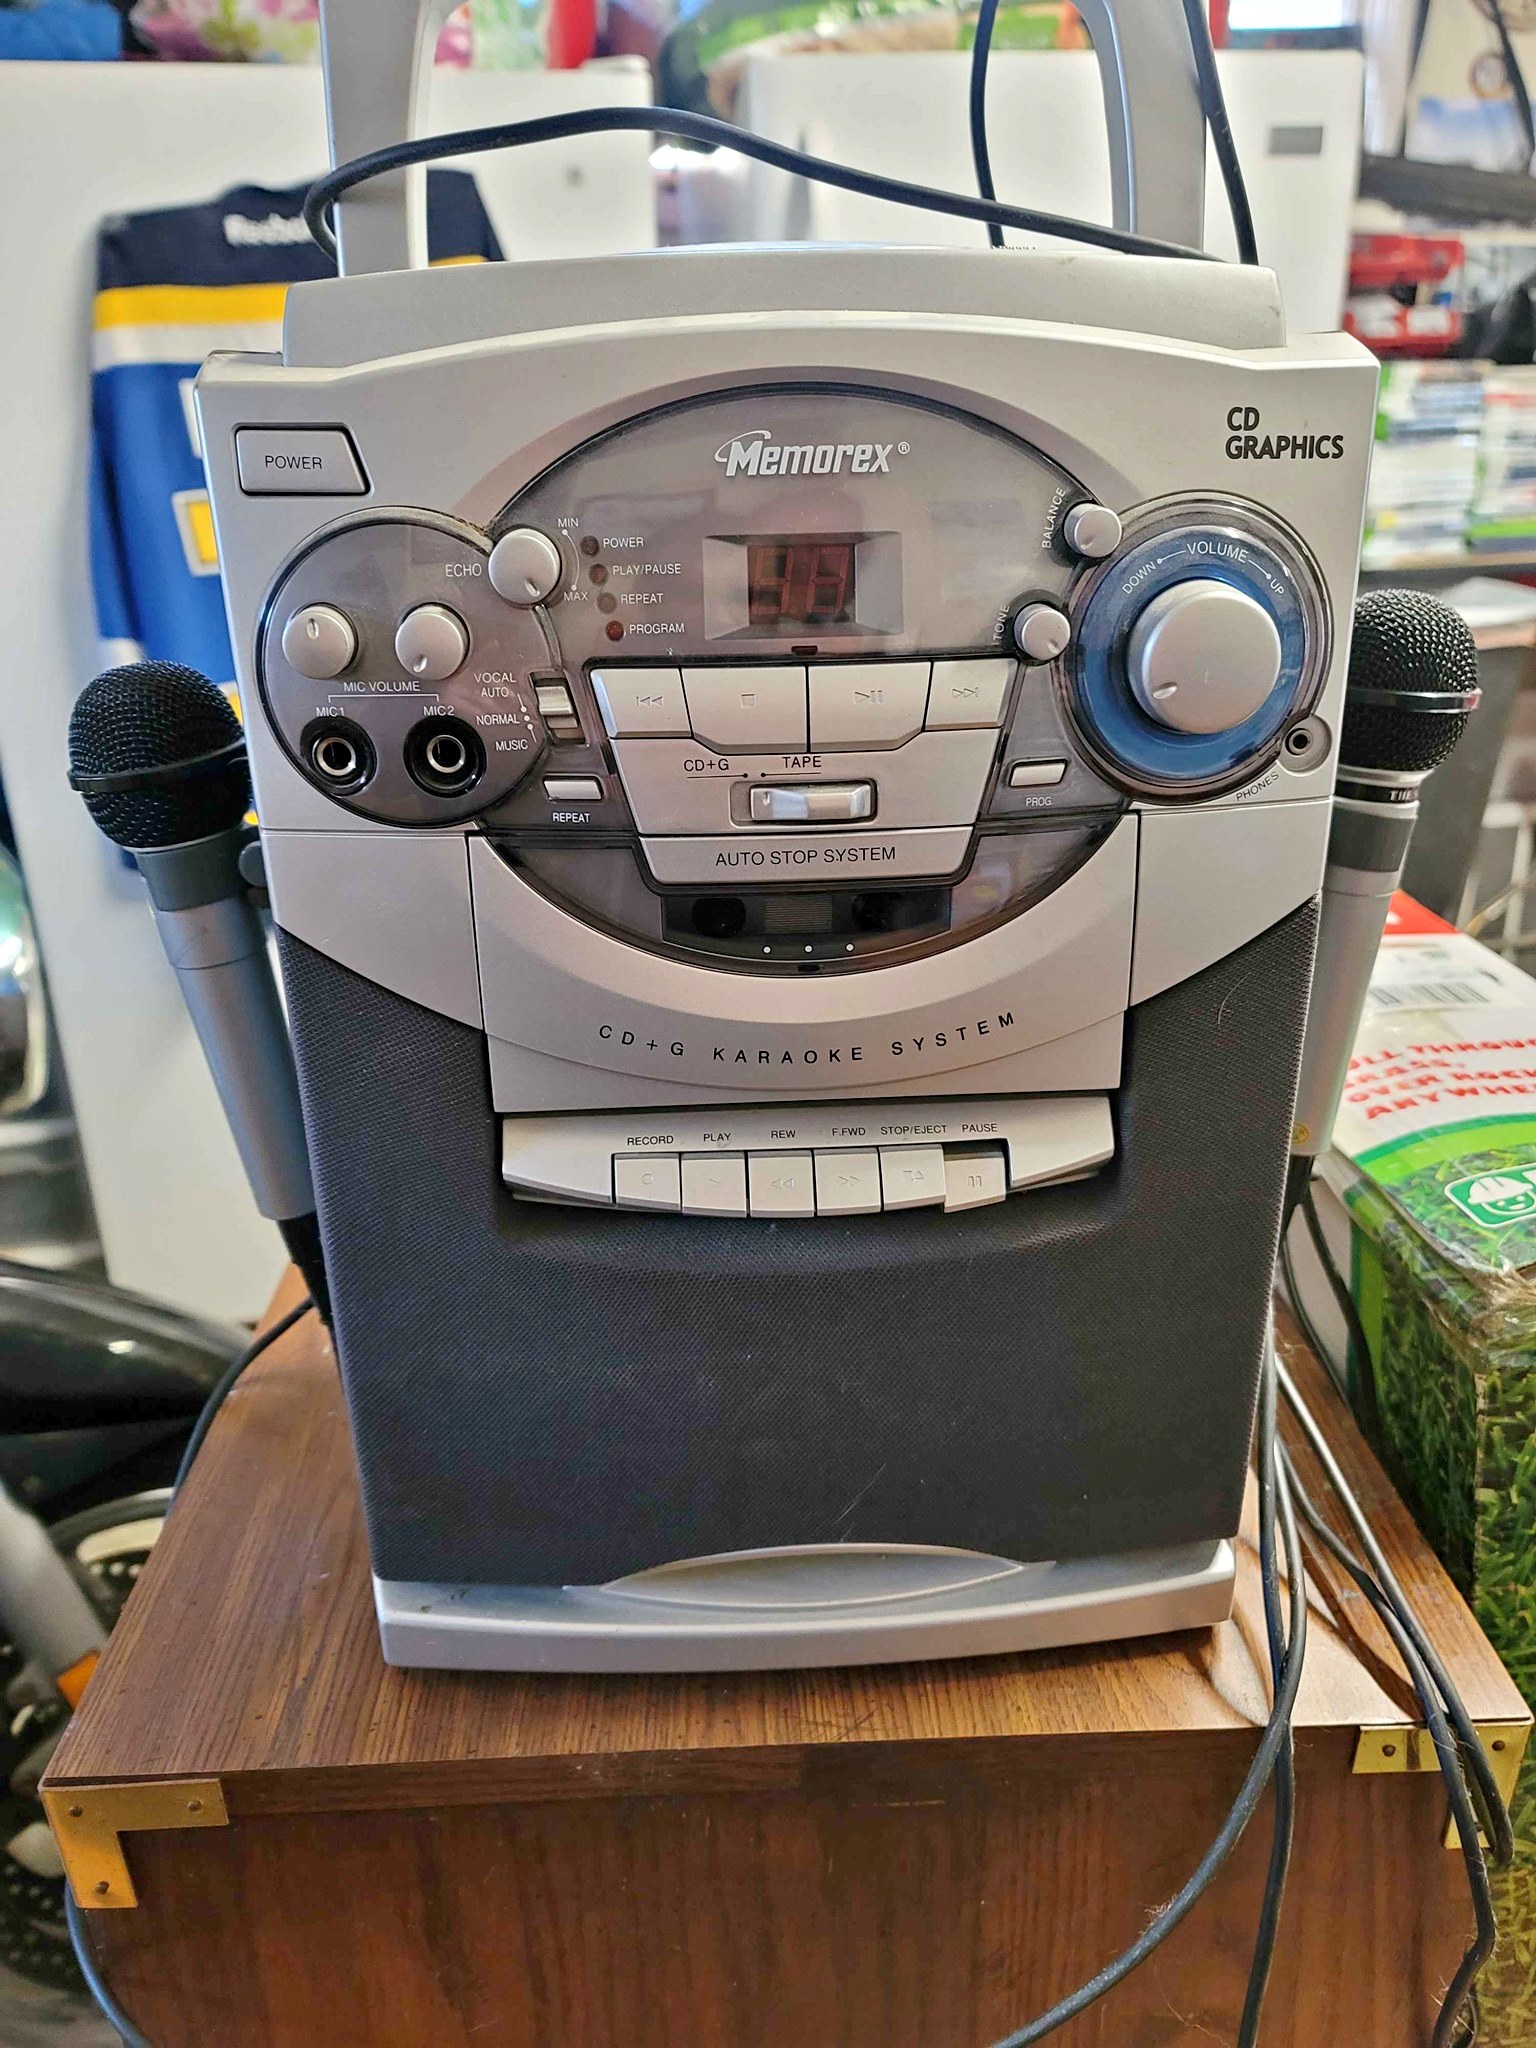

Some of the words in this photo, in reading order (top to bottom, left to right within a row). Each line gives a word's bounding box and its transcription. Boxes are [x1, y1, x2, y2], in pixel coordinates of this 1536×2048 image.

[1226, 406, 1260, 431] CD
[1225, 435, 1344, 460] GRAPHICS
[264, 455, 323, 470] POWER
[557, 517, 579, 528] MIN
[1041, 486, 1067, 549] BALANCE
[602, 537, 644, 548] POWER
[1186, 541, 1249, 564] VOLUME
[445, 563, 482, 577] ECHO
[612, 563, 682, 576] PLAY/PAUSE
[1122, 561, 1157, 595] DOWN
[1269, 578, 1285, 596] UP
[563, 592, 588, 601] MAX
[620, 593, 663, 604] REPEAT
[992, 604, 1010, 641] TONE
[629, 623, 685, 635] PROGRAM
[473, 672, 517, 684] VOCAL
[343, 681, 366, 693] MIC
[369, 680, 421, 692] VOLUME
[481, 687, 509, 698] AUTO
[476, 714, 520, 726] NORMAL
[495, 739, 529, 751] MUSIC
[683, 757, 730, 773] CD+G
[781, 755, 822, 769] TAPE
[1235, 771, 1279, 801] PHONES
[552, 812, 591, 823] REPEAT
[715, 851, 766, 867] AUTO
[770, 849, 818, 866] STOP
[823, 846, 896, 863] SYSTEM
[712, 1046, 863, 1064] KARAOKE
[890, 1011, 1015, 1056] SYSTEM
[771, 1129, 796, 1139] REW
[831, 1126, 866, 1137] F.FWD
[880, 1124, 948, 1136] STOP/EJECT
[961, 1123, 998, 1133] PAUSE
[626, 1135, 674, 1146] RECORD
[703, 1132, 732, 1143] PLAY
